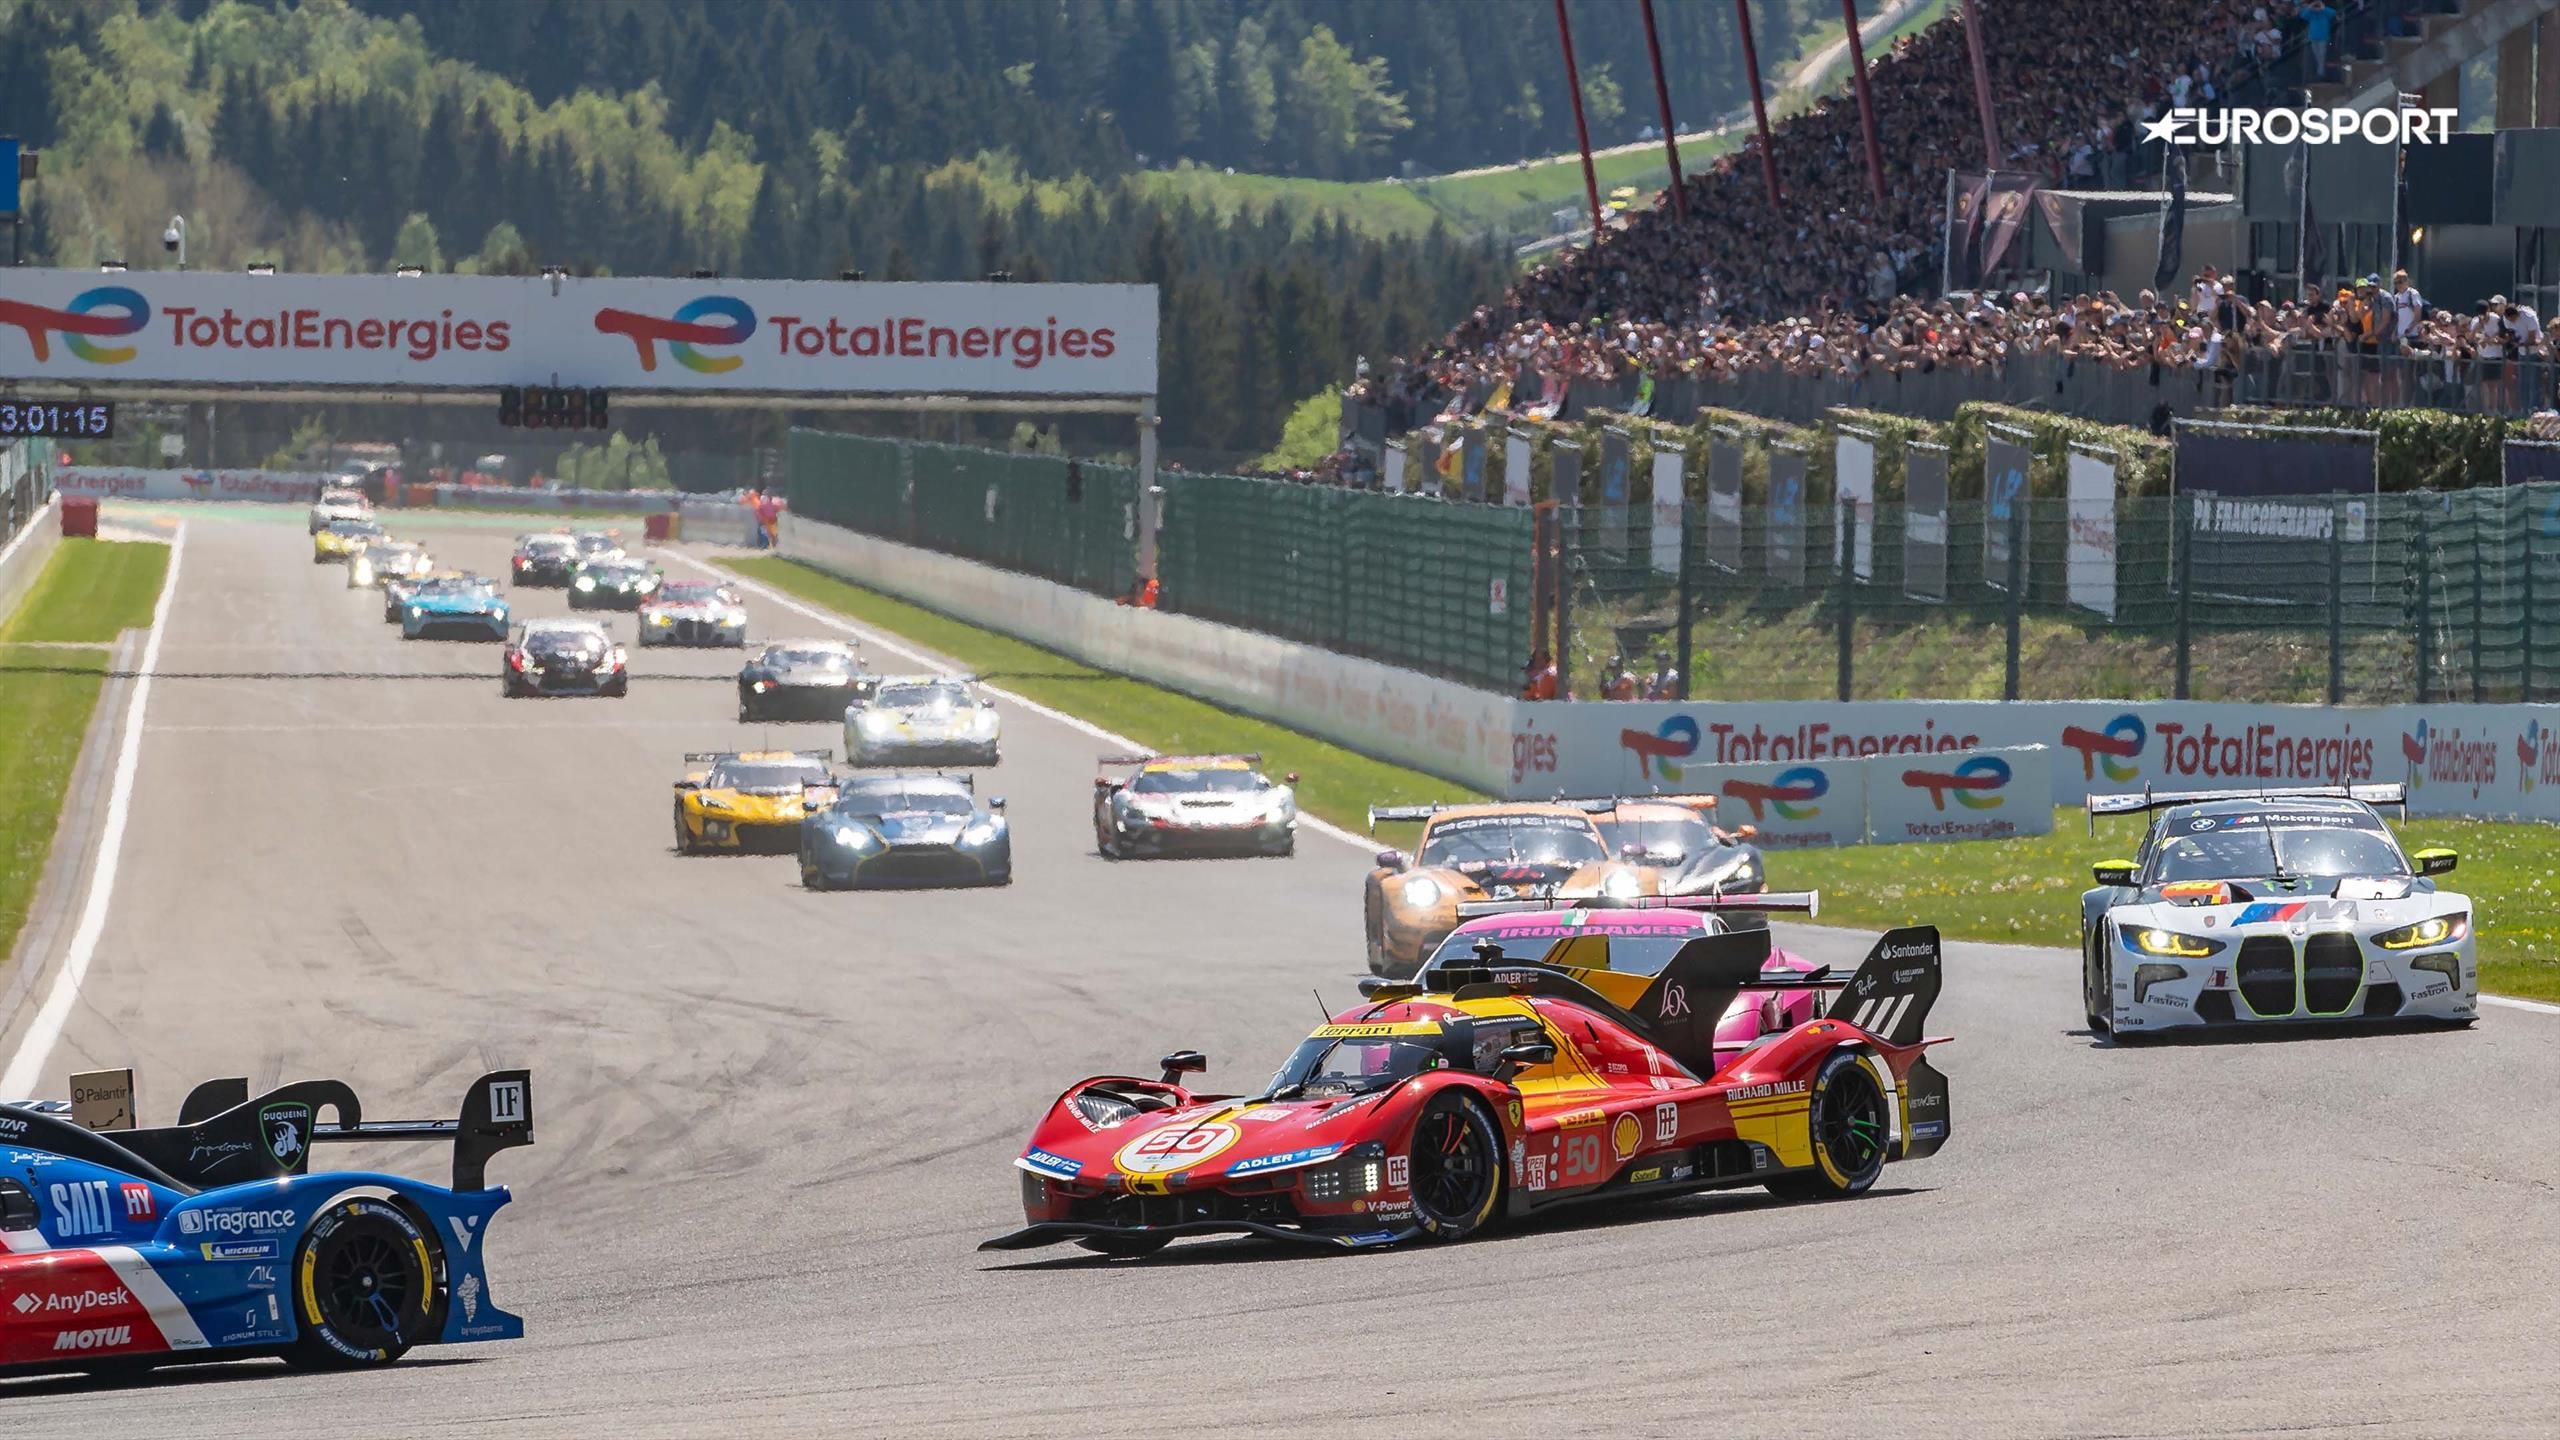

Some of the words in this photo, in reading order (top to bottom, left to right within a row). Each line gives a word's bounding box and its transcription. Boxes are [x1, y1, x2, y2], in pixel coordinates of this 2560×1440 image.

[163, 306, 511, 361] TotalEnergies
[768, 315, 1116, 369] TotalEnergies
[1511, 718, 1559, 783] gies
[2156, 723, 2374, 787] TotalEnergies
[2428, 725, 2497, 800] TotalEnergies
[2265, 814, 2355, 825] Motorsport
[1498, 927, 1577, 938] IRON
[1581, 925, 1689, 936] DAMES
[1891, 943, 1934, 959] Santander
[1494, 973, 1521, 983] ADLER
[2148, 994, 2189, 1009] Fastron
[2411, 986, 2449, 1001] Fastron
[1317, 1025, 1393, 1037] Ferrari
[86, 1087, 127, 1102] Palantir
[1726, 1083, 1771, 1102] RICHARD
[1773, 1080, 1806, 1095] MILLE
[495, 1087, 520, 1117] IF
[263, 1109, 308, 1121] DUQUEINE
[1305, 1104, 1356, 1131] RICHARD
[0, 1118, 28, 1132] TAR
[1143, 1129, 1217, 1151] 50
[1027, 1152, 1062, 1167] ADLER
[1236, 1153, 1294, 1171] ADLER
[1566, 1134, 1600, 1176] 50
[1528, 1169, 1544, 1188] AR
[51, 1181, 113, 1237] SALT
[124, 1189, 150, 1215] HY
[1367, 1201, 1410, 1212] V-Power
[204, 1208, 296, 1235] Fragrance
[224, 1246, 270, 1256] MICHELIN
[46, 1287, 129, 1314] AnyDesk
[53, 1325, 132, 1350] MOTUL
[222, 1331, 255, 1342] SIGNUM
